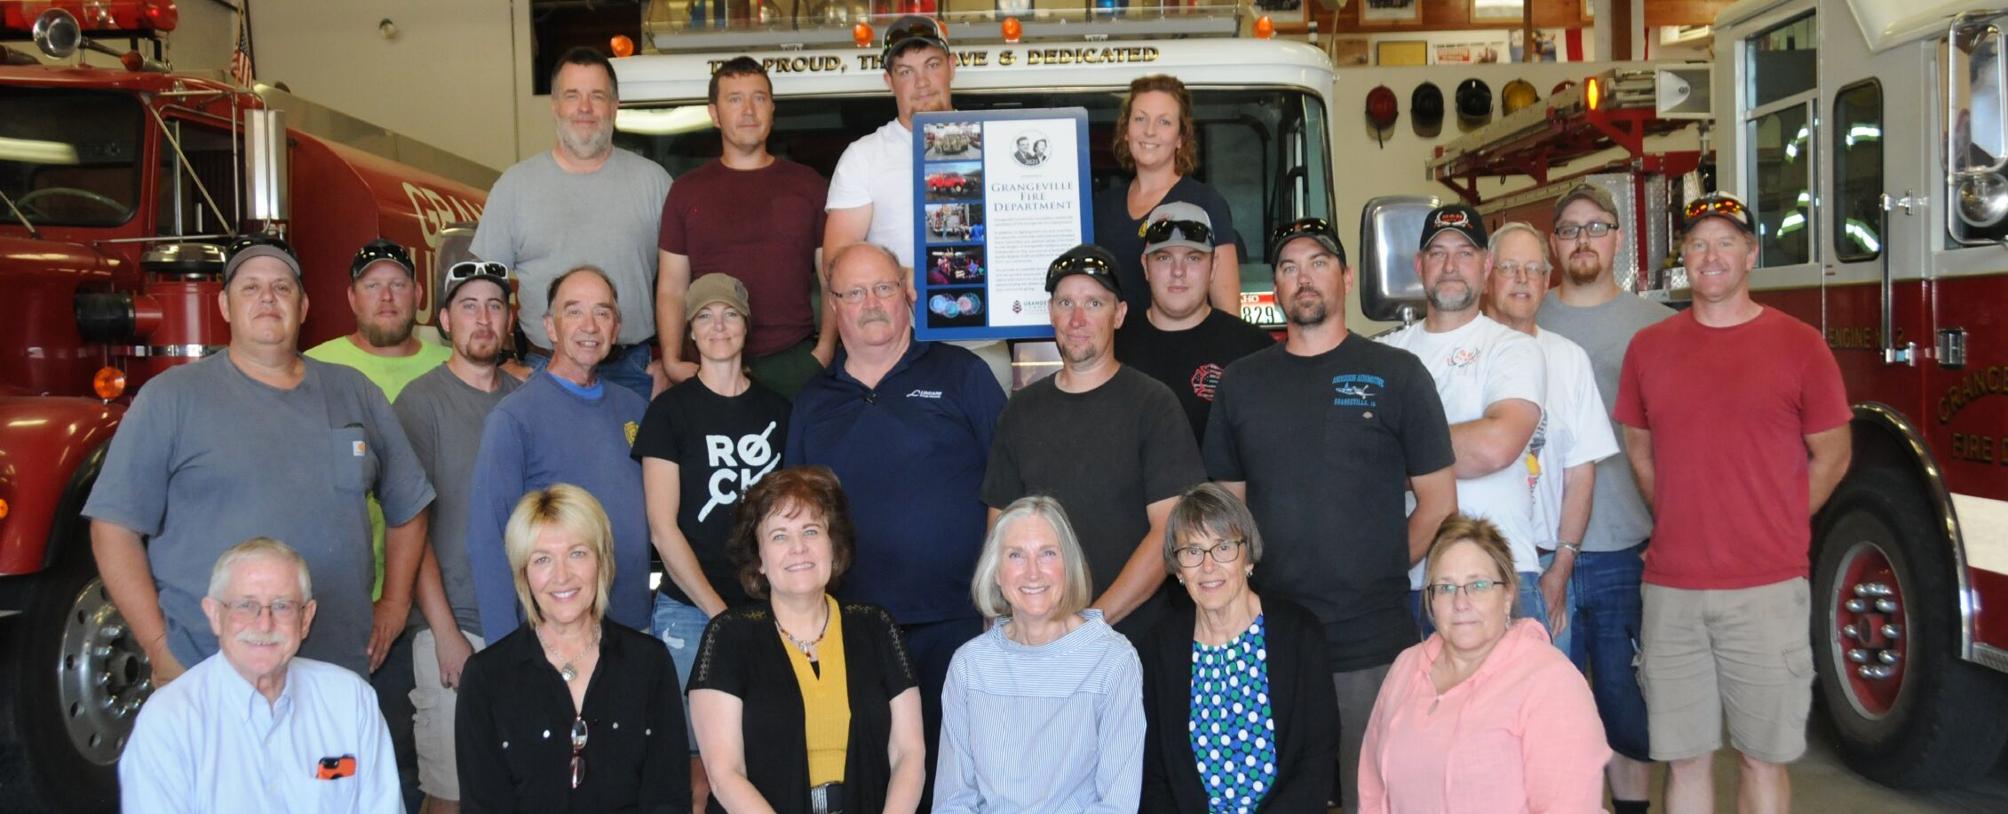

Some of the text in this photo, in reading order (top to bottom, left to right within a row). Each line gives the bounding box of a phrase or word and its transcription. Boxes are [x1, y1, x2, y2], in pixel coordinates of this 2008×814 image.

[763, 47, 1160, 73] PROUD, TH AVE & DEDICATED
[991, 181, 1074, 193] GRANGEVILLE
[1020, 191, 1046, 201] FIRE
[993, 201, 1072, 213] DEPARTMENT
[1828, 327, 1872, 349] ENGINE
[1897, 327, 1906, 348] 2
[1952, 432, 1995, 463] FIRE
